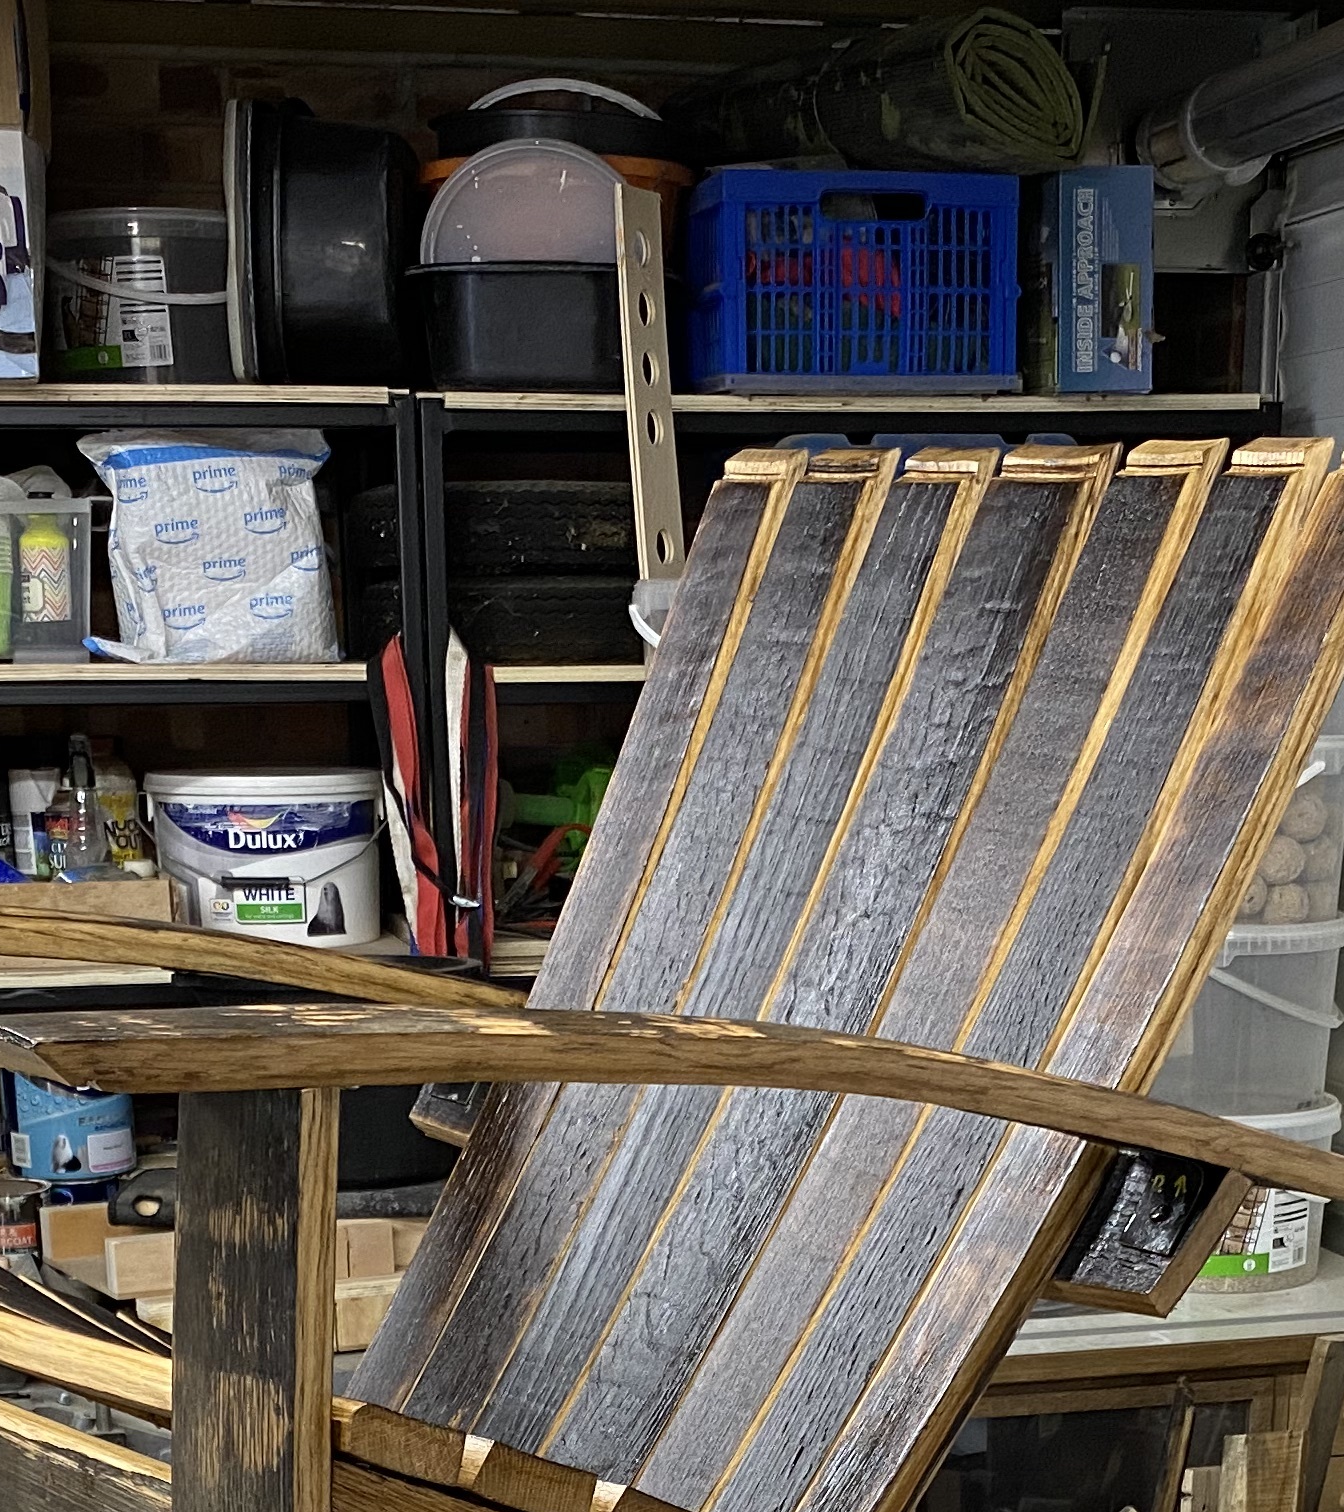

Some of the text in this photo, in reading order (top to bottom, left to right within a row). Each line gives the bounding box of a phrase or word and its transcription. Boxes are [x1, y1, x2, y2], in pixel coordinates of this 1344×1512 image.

[1076, 188, 1094, 373] INSIDE APPROACH
[193, 464, 237, 484] prime
[244, 505, 287, 523] prime
[155, 517, 198, 535] prime
[203, 556, 246, 573] prime
[249, 593, 293, 610] prime
[163, 602, 205, 620] prime
[228, 828, 297, 850] Dulux
[243, 887, 296, 901] WHITE
[259, 905, 279, 914] SILK
